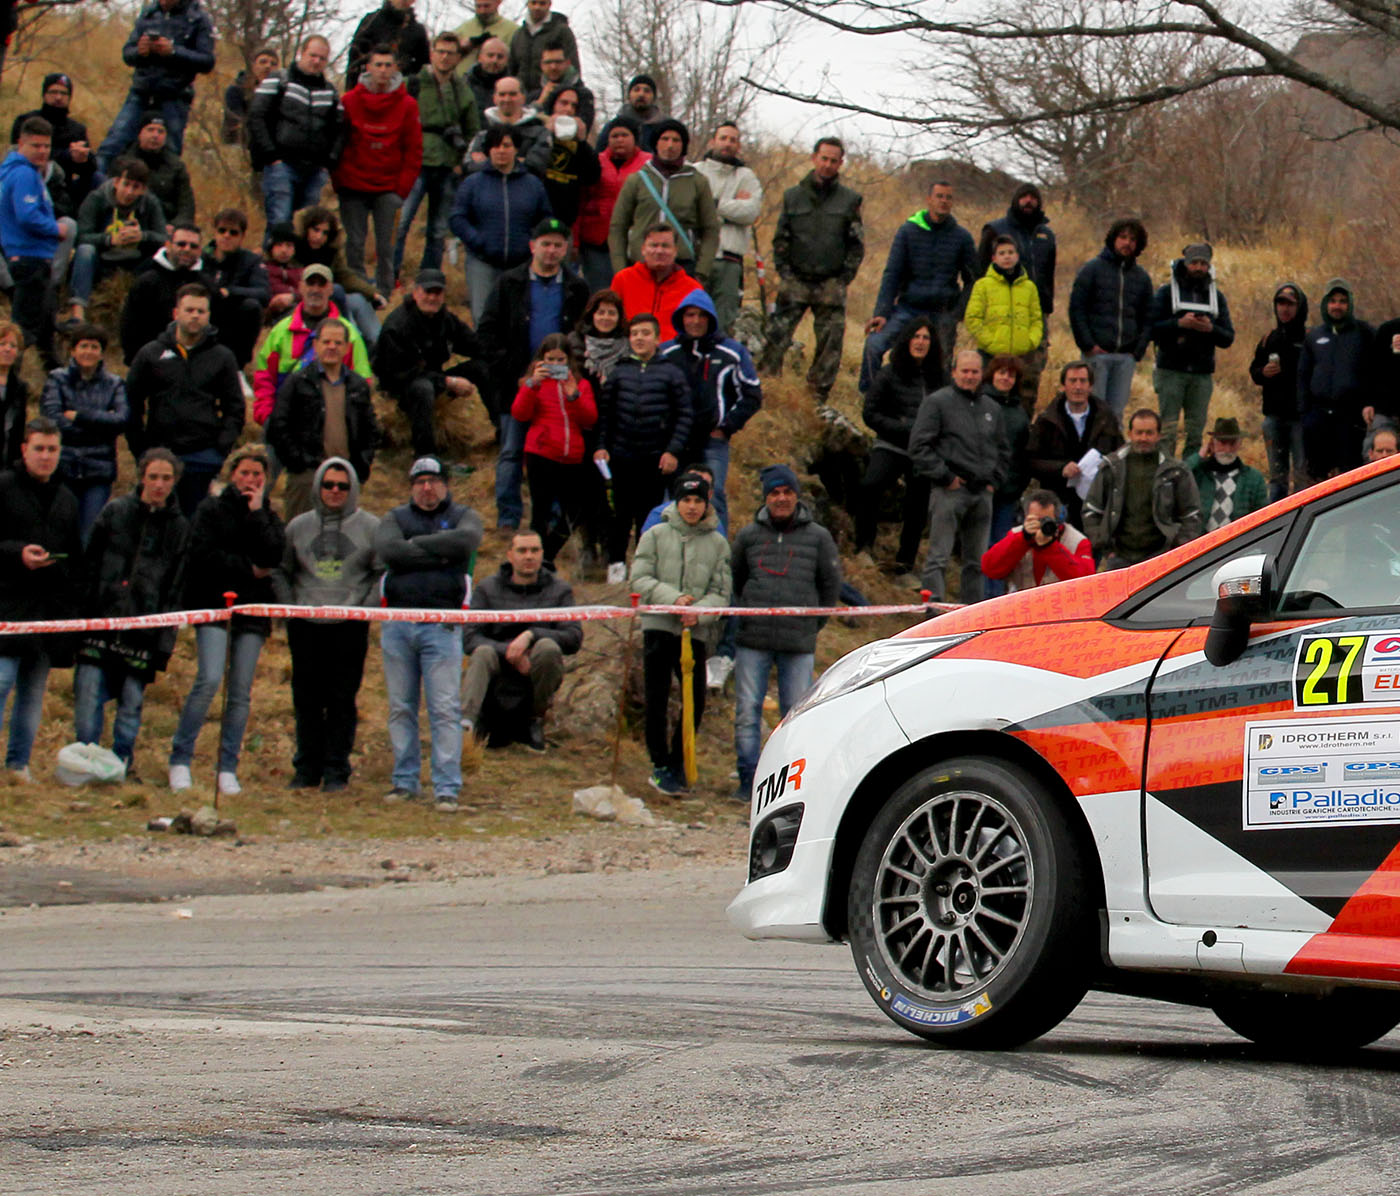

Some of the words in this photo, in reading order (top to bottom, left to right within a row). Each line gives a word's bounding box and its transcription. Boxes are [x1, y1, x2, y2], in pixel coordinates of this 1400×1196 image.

[1356, 616, 1400, 629] TMR
[1074, 648, 1116, 664] TMR
[1229, 667, 1272, 681] TMR
[1302, 635, 1367, 705] 27
[1248, 681, 1290, 699] TMR
[1196, 692, 1239, 711] TMR
[1282, 731, 1370, 743] IDROTHERM
[1299, 740, 1376, 750] www.idrotherm.net
[1077, 751, 1119, 768] TMR
[1259, 765, 1320, 776] GPS
[756, 757, 807, 816] TMR
[1172, 771, 1213, 788] TMR
[1269, 808, 1301, 816] INDUSTRIE
[1302, 807, 1336, 815] GRAFICHE
[1336, 805, 1392, 813] CARTOTECNICHE
[894, 1000, 961, 1022] MICHELIN
